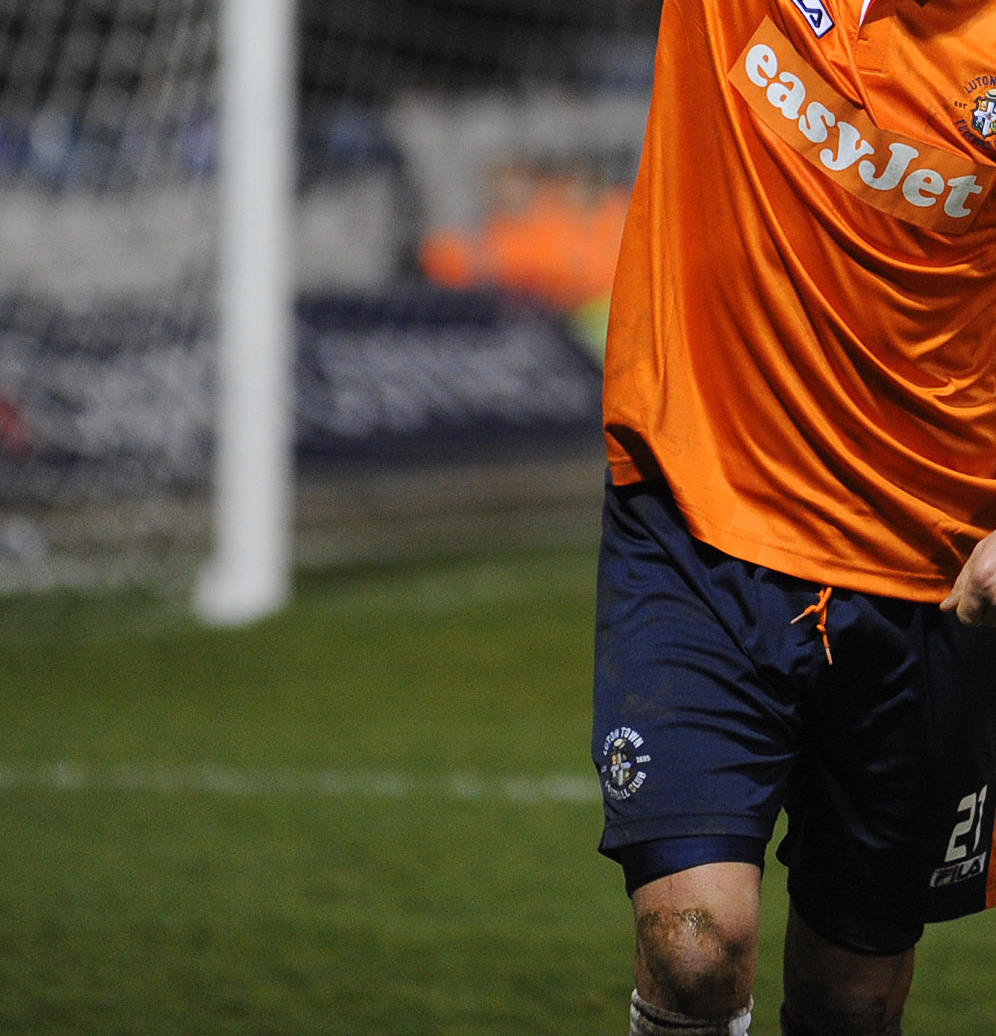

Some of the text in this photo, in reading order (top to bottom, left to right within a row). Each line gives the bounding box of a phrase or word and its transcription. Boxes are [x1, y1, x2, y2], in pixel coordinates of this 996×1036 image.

[744, 43, 984, 219] easyJet
[620, 726, 645, 749] TOWN
[628, 770, 647, 793] CLUB
[943, 783, 988, 863] 21
[934, 857, 983, 885] FILA
